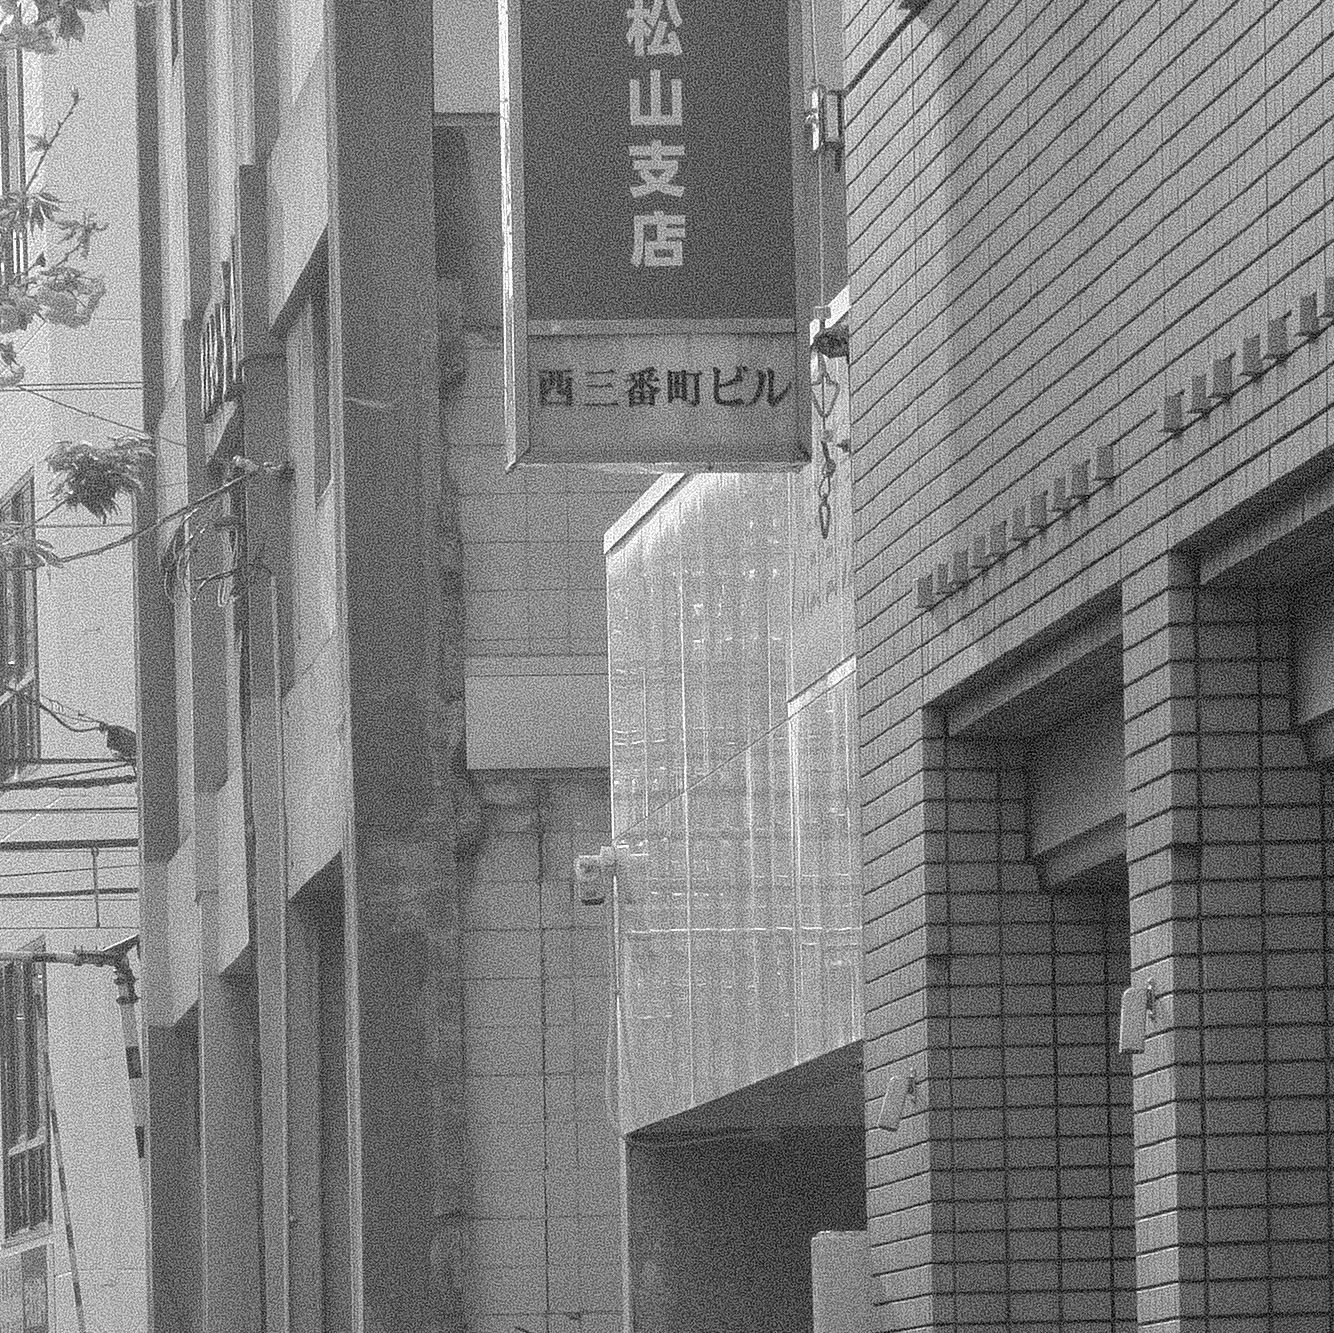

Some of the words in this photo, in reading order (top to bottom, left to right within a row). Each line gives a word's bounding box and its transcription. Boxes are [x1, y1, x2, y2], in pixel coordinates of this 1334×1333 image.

[624, 0, 687, 268] 松山支店
[537, 367, 792, 408] 西三番町ビル
